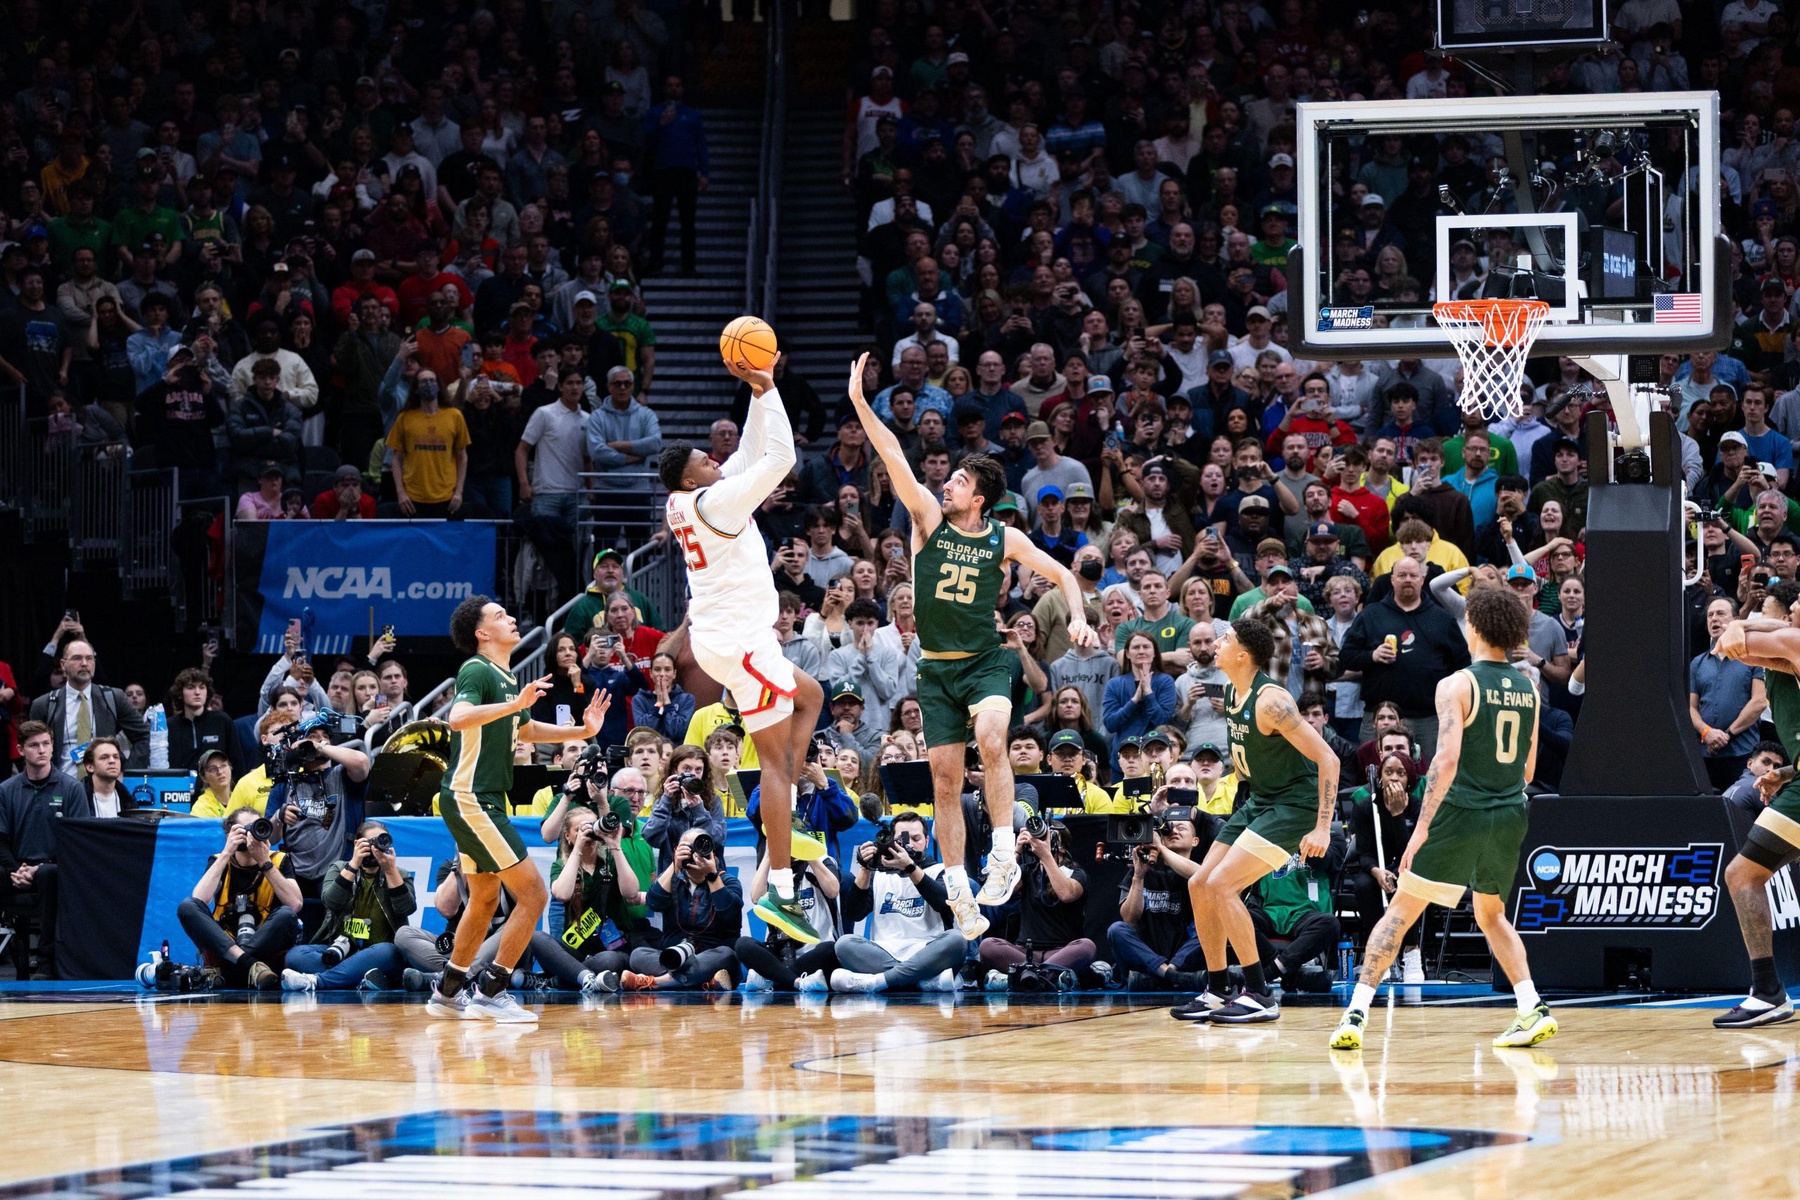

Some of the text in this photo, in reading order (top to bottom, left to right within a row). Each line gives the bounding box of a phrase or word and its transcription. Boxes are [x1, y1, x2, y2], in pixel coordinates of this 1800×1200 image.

[1330, 309, 1358, 318] MARCH
[1333, 318, 1371, 327] MADNESS
[937, 540, 993, 559] COLORADO
[947, 551, 979, 564] STATE
[935, 562, 980, 604] 25
[1061, 673, 1093, 683] Hurley
[1486, 689, 1534, 708] K.C. EVANS
[1495, 710, 1520, 763] 0
[1536, 865, 1560, 874] NCAA
[1562, 854, 1665, 883] MARCH
[891, 895, 914, 908] MARCH
[1146, 892, 1170, 901] MARCH
[1574, 886, 1714, 915] MADNESS
[892, 903, 925, 915] MADNESS
[1149, 900, 1180, 911] MADNESS
